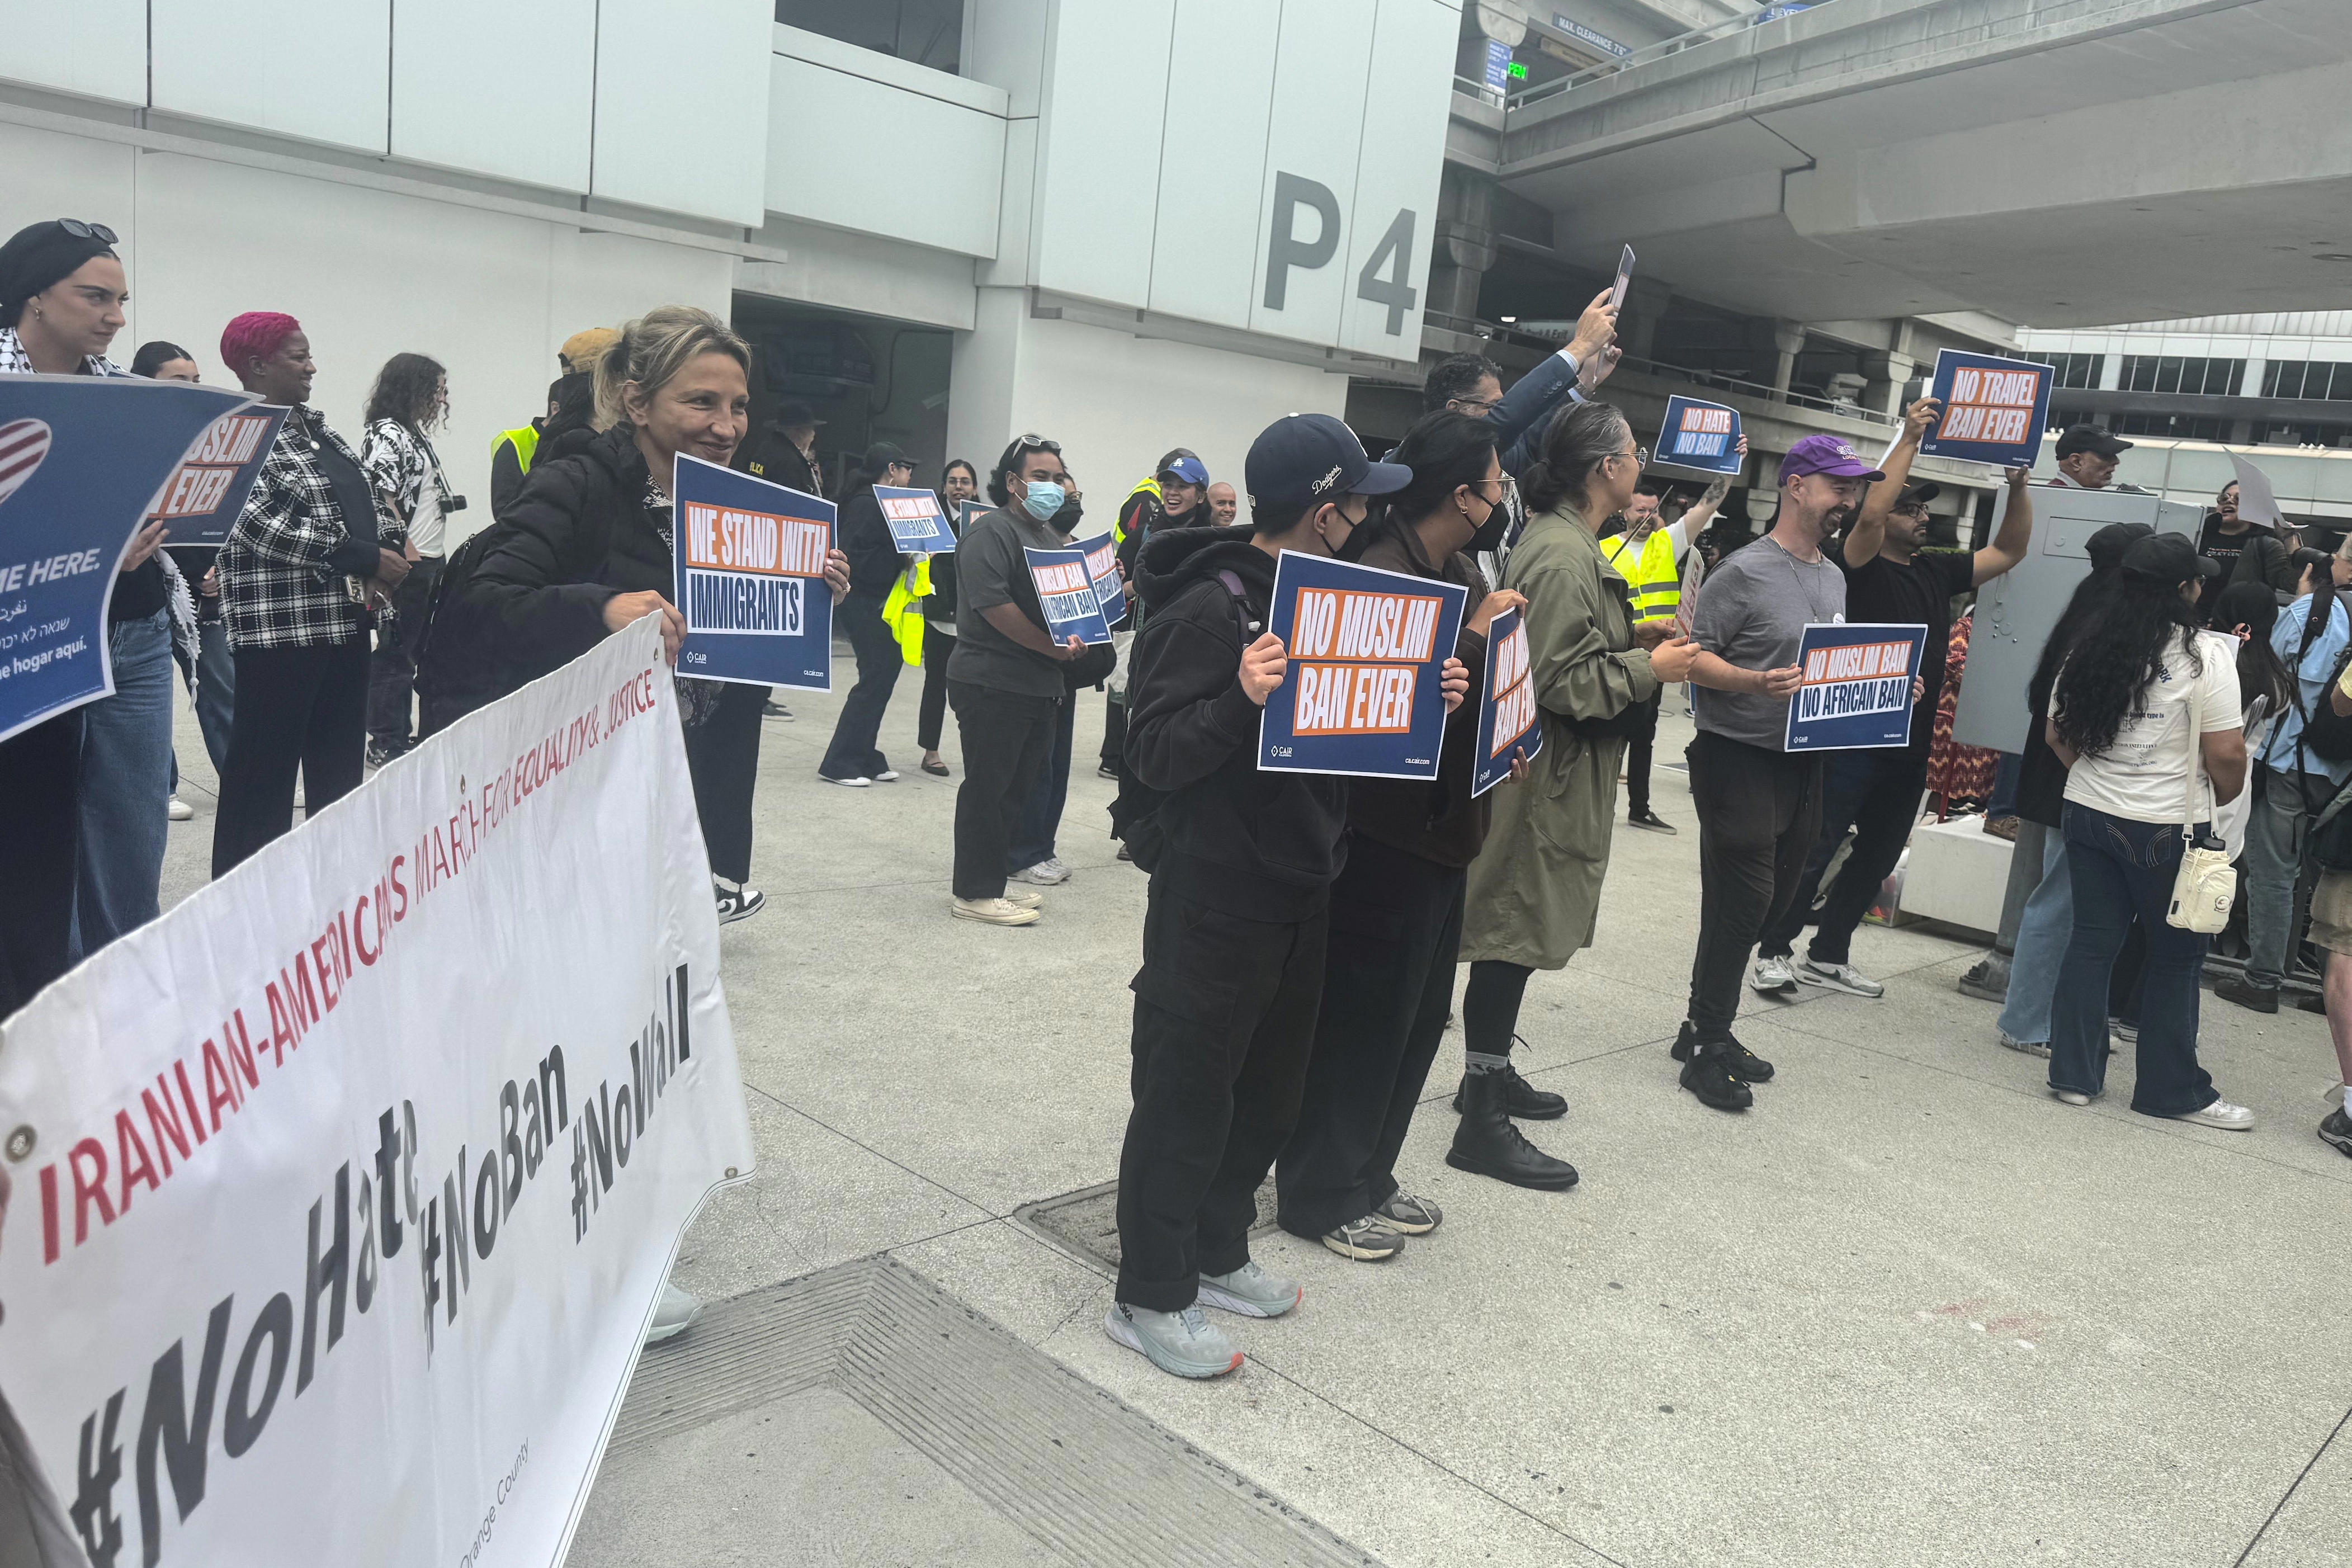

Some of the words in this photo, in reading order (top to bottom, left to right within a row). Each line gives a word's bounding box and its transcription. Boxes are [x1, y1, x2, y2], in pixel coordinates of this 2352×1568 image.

[1558, 17, 1575, 32] MAX.
[1576, 26, 1612, 50] CLEARANCE
[1508, 62, 1526, 79] PEN
[1264, 171, 1416, 336] P4
[1952, 370, 1980, 403] NO
[1980, 372, 2035, 405] TRAVEL
[1683, 409, 1702, 431] NO
[1702, 410, 1730, 433] HATE
[1943, 407, 1985, 439] BAN
[1981, 409, 2027, 441] EVER
[1676, 432, 1696, 454] NO
[1695, 434, 1722, 456] BAN
[166, 469, 233, 514] EVER
[1311, 464, 1342, 495] Dodgers
[689, 507, 717, 564] WE
[721, 511, 777, 569] STAND
[781, 520, 826, 574] WITH
[892, 519, 936, 537] IMMIGRANTS
[28, 547, 101, 586] HERE.
[1065, 563, 1087, 588] BAN
[691, 574, 799, 631] IMMIGRANTS
[1075, 591, 1097, 615] BAN
[1095, 575, 1114, 602] FRICAN
[0, 634, 18, 649] יכו
[22, 625, 37, 643] לא
[40, 617, 70, 637] שנאה
[1295, 592, 1336, 657] NO
[1335, 595, 1438, 658] MUSLIM
[13, 650, 54, 674] hogar
[55, 635, 87, 659] aquí.
[1494, 635, 1514, 697] NO
[1805, 650, 1827, 681] NO
[1826, 645, 1882, 679] MUSLIM
[1879, 643, 1911, 674] BAN
[1296, 667, 1352, 730] BAN
[1350, 669, 1414, 728] EVER
[1802, 687, 1820, 718] NO
[1822, 681, 1877, 716] AFRICAN
[1877, 677, 1907, 709] BAN
[1493, 686, 1522, 753] BAN
[40, 854, 408, 1266] IRANIAN-AMERICANS
[414, 800, 479, 905] MARCH
[484, 767, 511, 838] FOR
[603, 668, 655, 740] JUSTICE
[570, 962, 690, 1246] #NoWall
[420, 1044, 568, 1372] #NoBan
[1117, 1302, 1133, 1322] OKA
[70, 1099, 418, 1568] #NoHate
[497, 1436, 528, 1505] County
